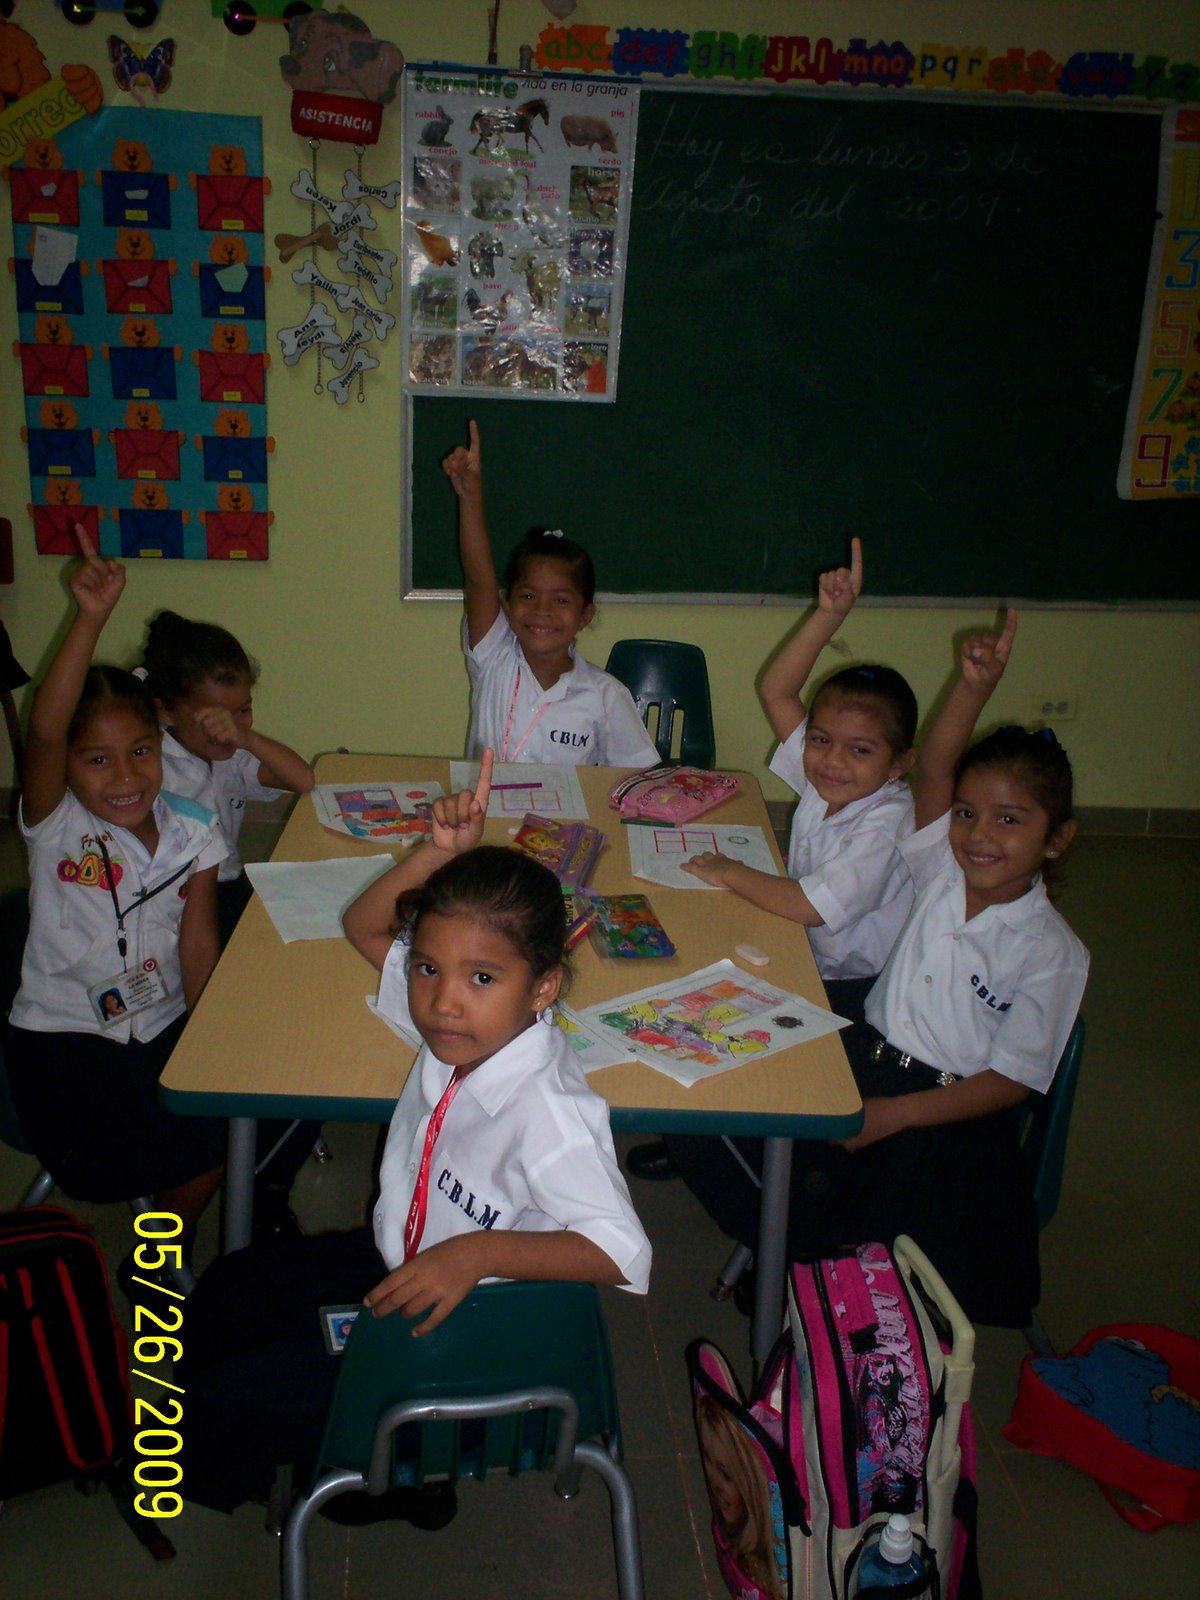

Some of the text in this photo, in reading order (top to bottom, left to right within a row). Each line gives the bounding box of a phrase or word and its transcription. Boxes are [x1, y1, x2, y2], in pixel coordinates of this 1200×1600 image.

[545, 31, 602, 62] abc
[620, 35, 681, 69] def
[696, 41, 756, 69] ghi
[771, 42, 828, 75] jkl
[843, 52, 906, 75] mno
[920, 53, 983, 80] pqr
[551, 81, 567, 91] en
[571, 80, 583, 92] la
[587, 83, 628, 98] granja
[299, 106, 374, 135] ASISTENCIA
[611, 109, 625, 118] pig
[649, 102, 725, 189] Hoy
[305, 186, 337, 212] Keren
[359, 184, 388, 199] Carlos
[333, 214, 362, 236] Jordi
[1164, 229, 1200, 289] 3
[310, 272, 338, 296] Yailin
[294, 318, 317, 338] Ana
[1155, 300, 1193, 358] 5
[1146, 366, 1184, 424] 7
[1134, 434, 1173, 488] 9
